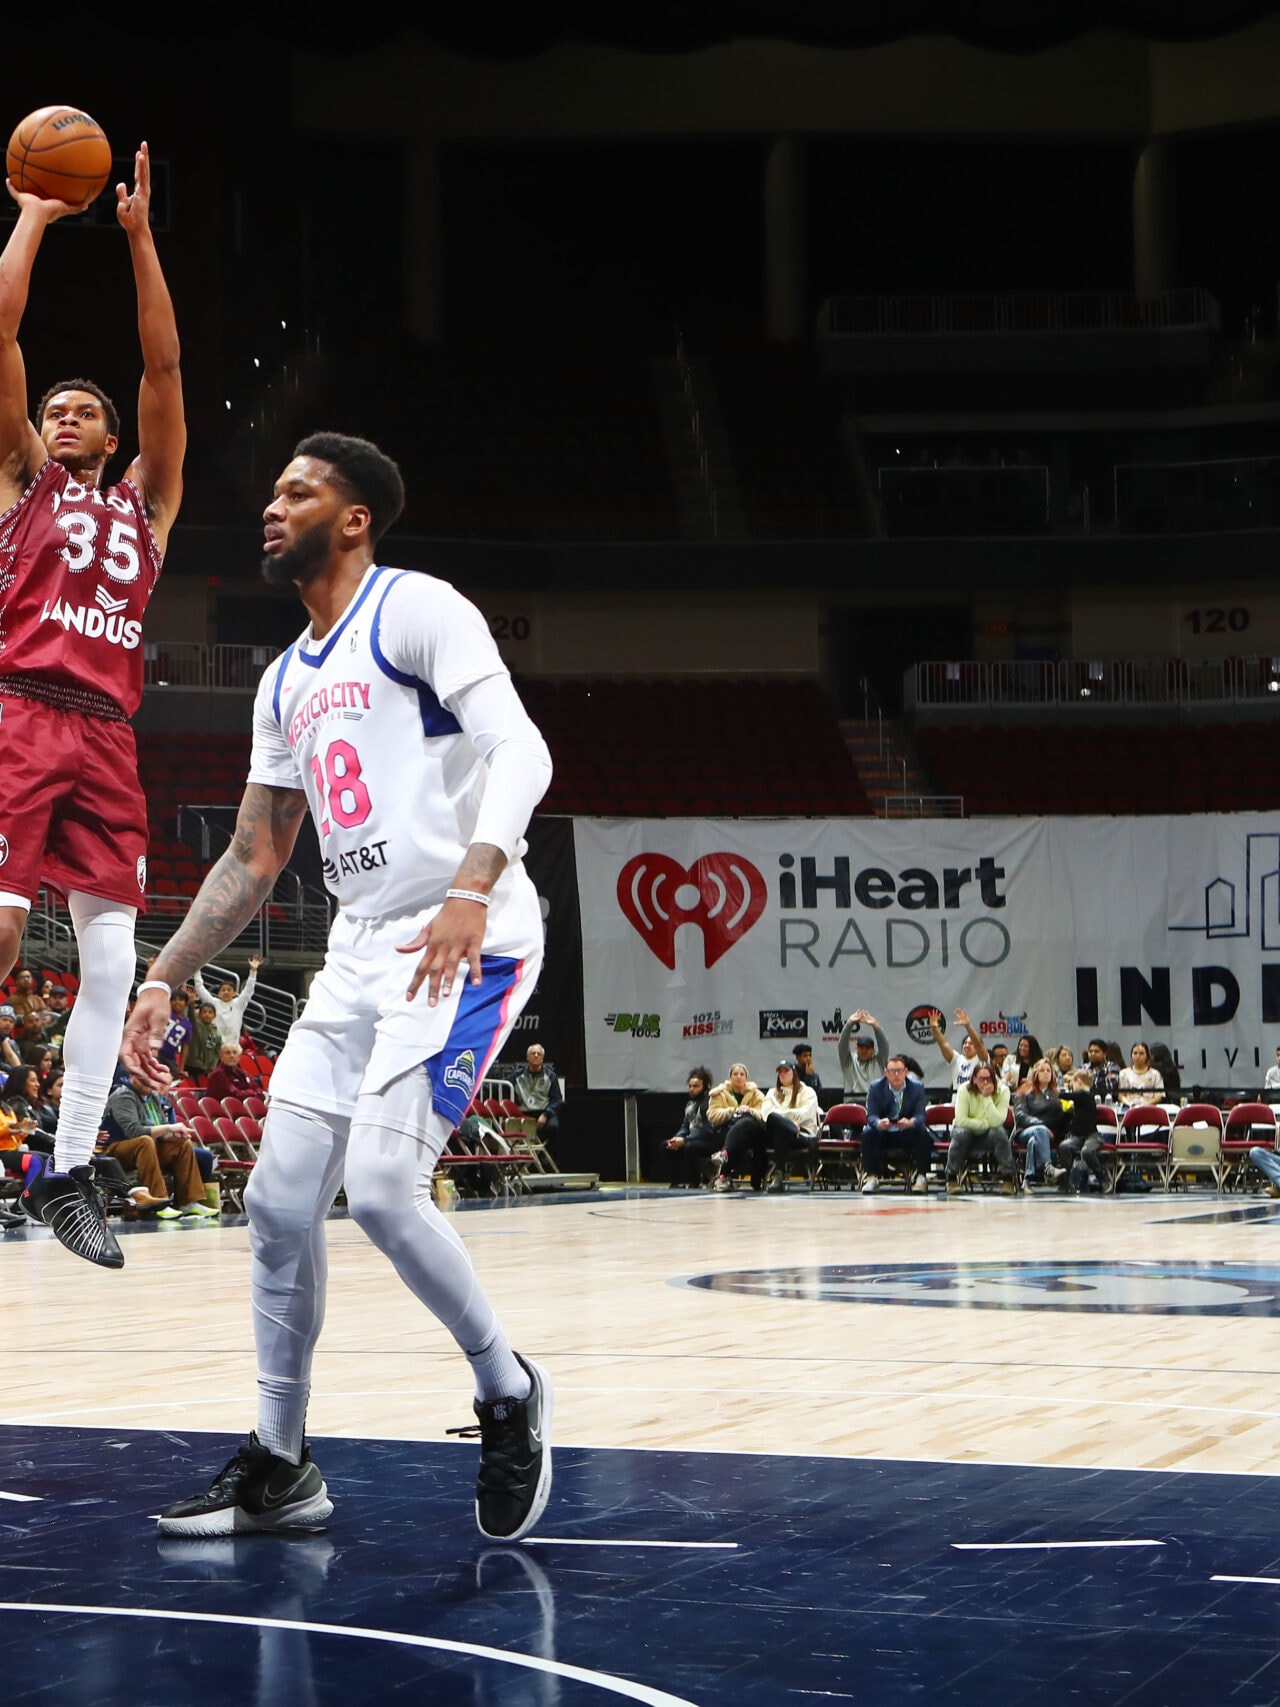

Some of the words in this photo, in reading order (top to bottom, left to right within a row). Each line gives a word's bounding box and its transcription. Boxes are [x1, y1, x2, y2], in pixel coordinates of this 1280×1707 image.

[55, 509, 140, 585] 35
[39, 596, 143, 650] LANDUS
[1185, 607, 1250, 634] 120
[331, 682, 371, 709] CITY
[339, 840, 387, 876] AT&T
[779, 853, 1007, 910] iHeart
[780, 917, 1011, 969] RADIO
[613, 1013, 661, 1032] BUS
[682, 1022, 714, 1038] KISS
[692, 1010, 721, 1024] 107.5
[630, 1026, 661, 1039] 100.3
[1173, 1047, 1260, 1070] LIVI
